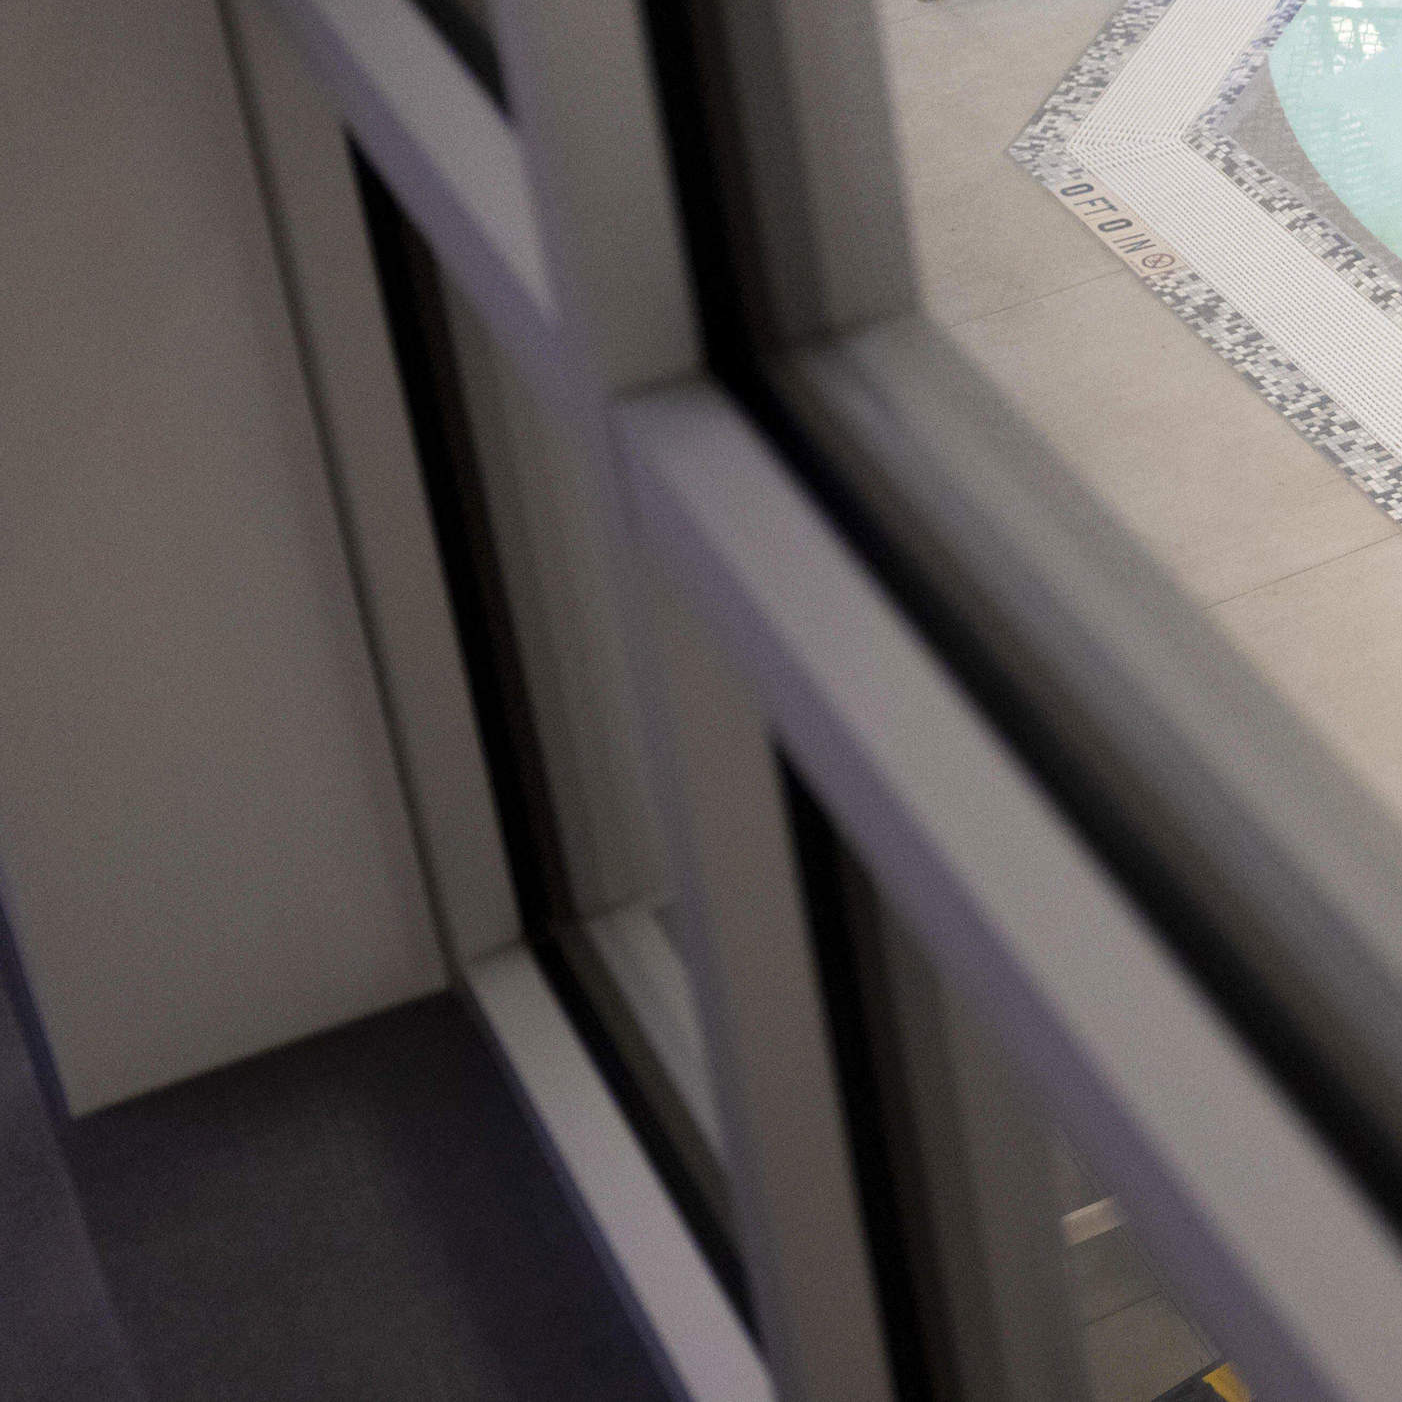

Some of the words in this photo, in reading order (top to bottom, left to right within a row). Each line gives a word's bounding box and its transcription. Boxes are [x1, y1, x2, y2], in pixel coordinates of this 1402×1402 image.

[1060, 182, 1095, 197] 0
[1073, 196, 1119, 216] FT
[1097, 217, 1134, 233] 0
[1111, 232, 1157, 254] IN
